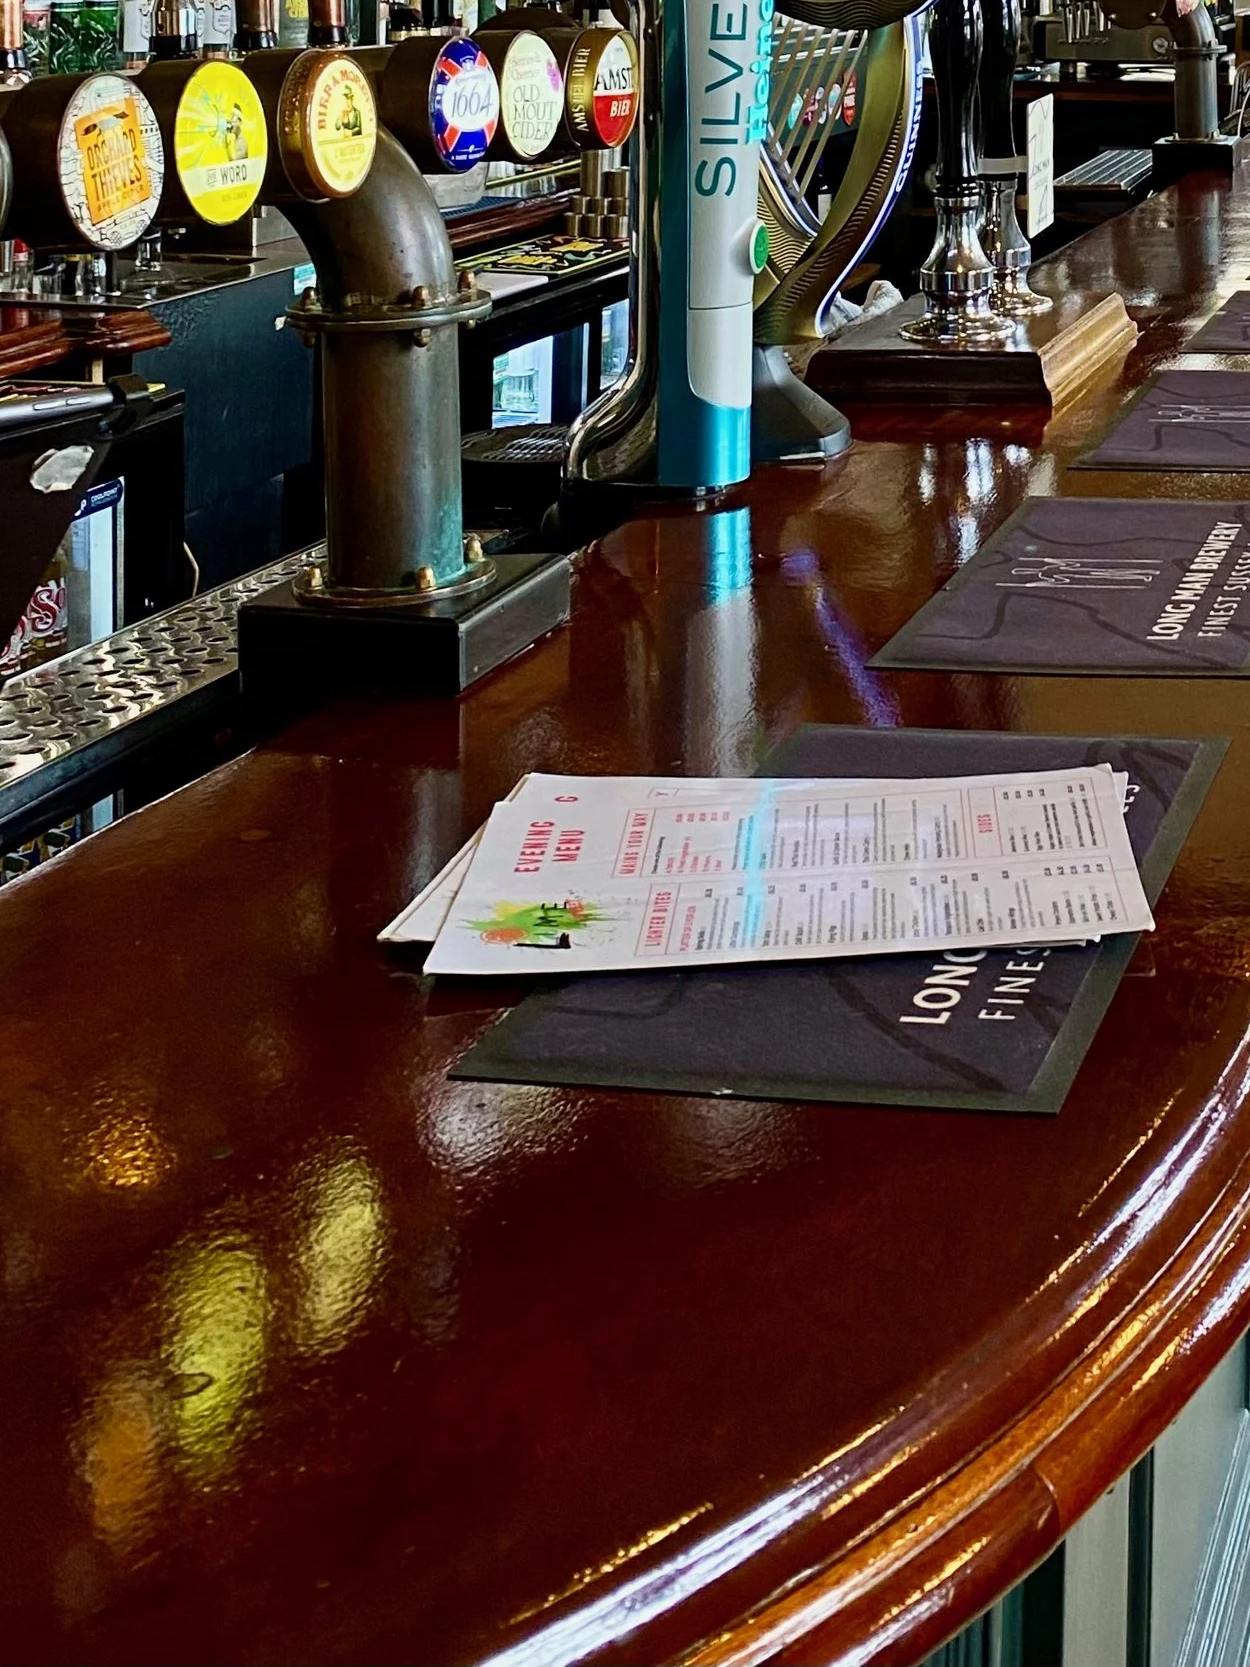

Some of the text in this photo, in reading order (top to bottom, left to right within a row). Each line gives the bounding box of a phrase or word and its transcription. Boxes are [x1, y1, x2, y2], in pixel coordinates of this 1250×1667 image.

[572, 48, 591, 77] BIER
[513, 84, 540, 104] OLD
[594, 67, 633, 91] AMST
[451, 83, 493, 118] 1664
[514, 101, 558, 122] MOUT
[610, 99, 631, 118] BIER
[512, 120, 550, 141] CIDER
[87, 129, 136, 171] ORCHARD
[92, 157, 142, 201] THIEVES
[220, 164, 247, 183] WORD
[1146, 521, 1243, 640] LONG MAN BREWERY
[1197, 595, 1241, 637] FINEST
[632, 812, 649, 830] WAY
[977, 813, 993, 833] SIDES
[514, 821, 556, 873] EVENING
[552, 830, 585, 863] MENU
[626, 828, 644, 849] YOUR
[513, 902, 571, 949] LIME
[644, 915, 666, 948] LIGHTER
[978, 947, 1052, 1021] FINE
